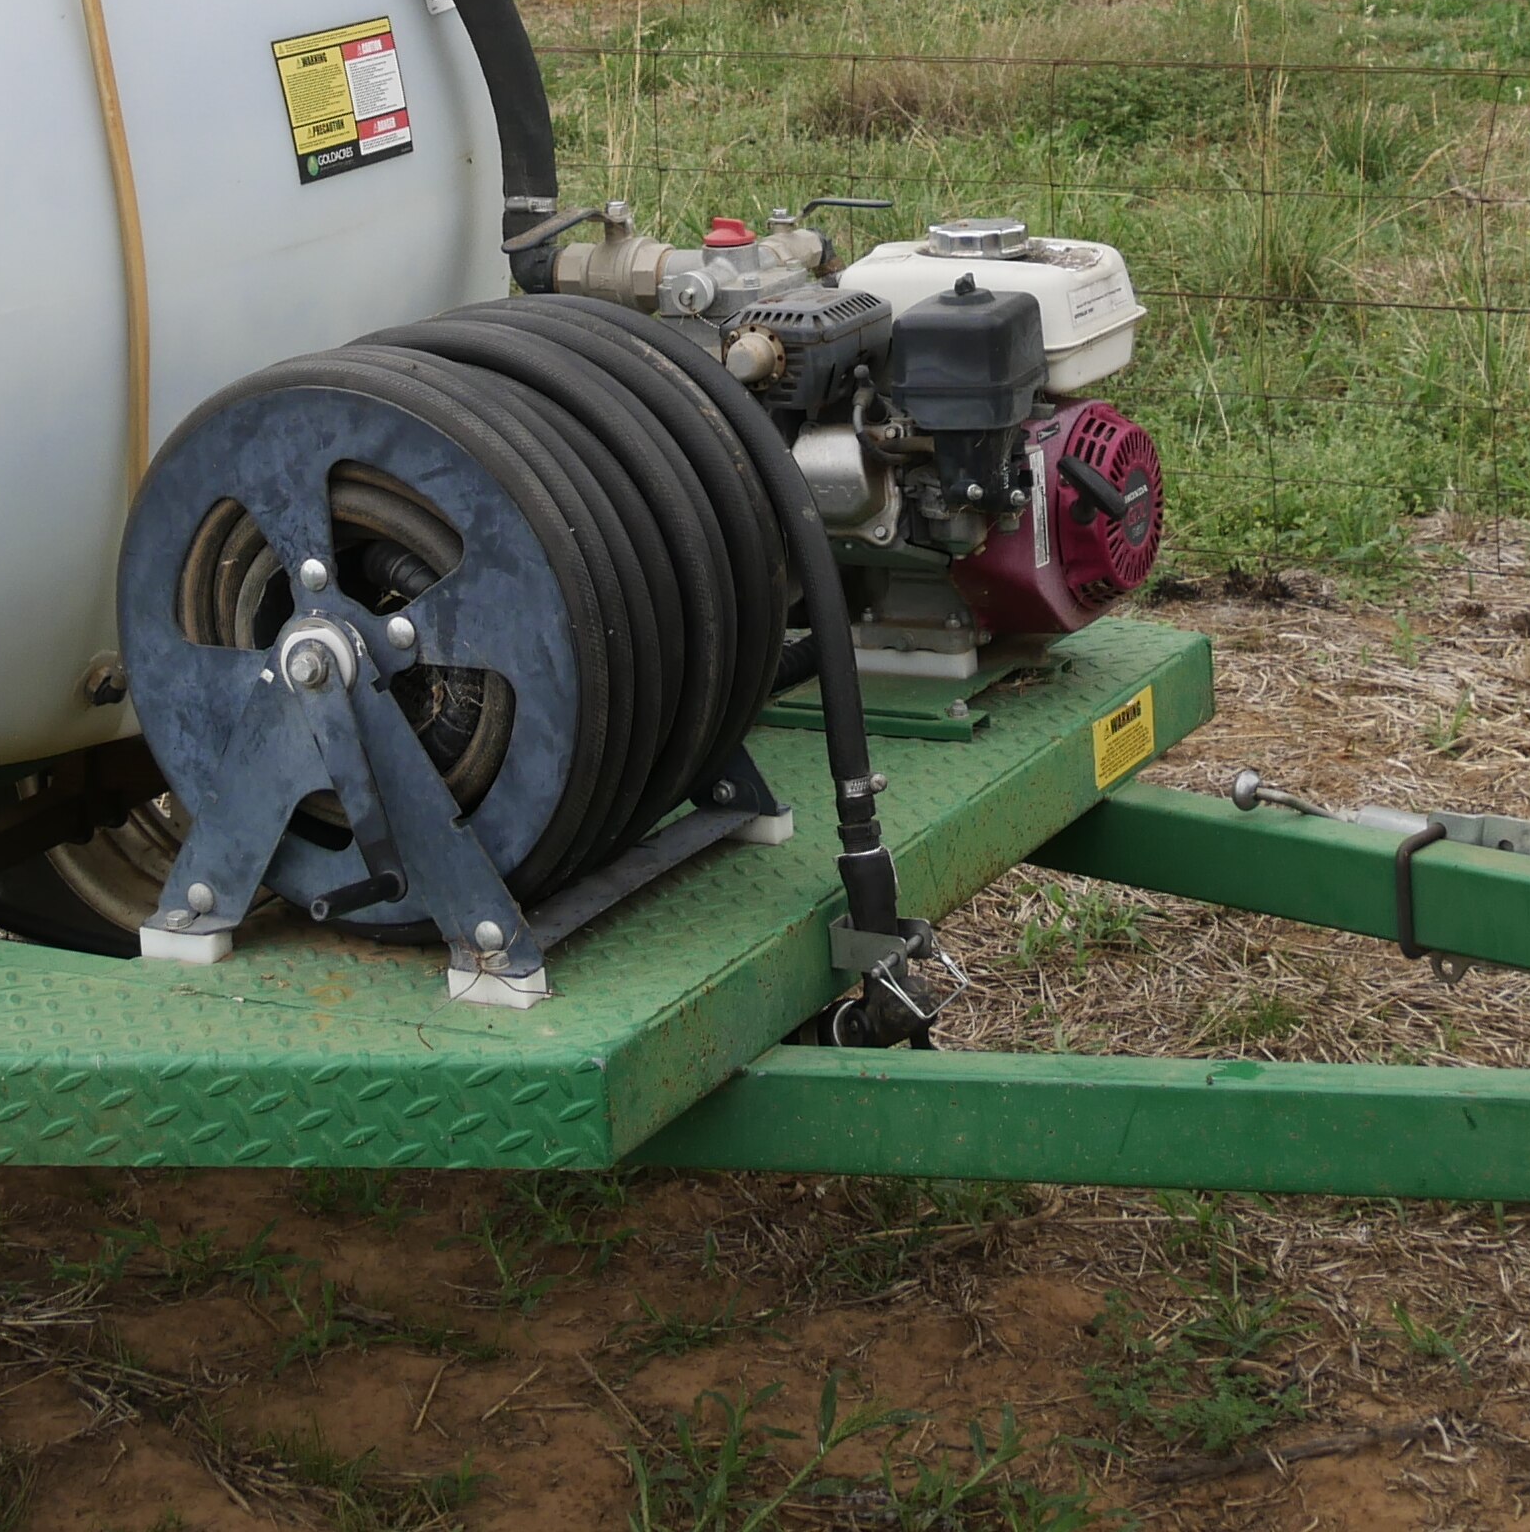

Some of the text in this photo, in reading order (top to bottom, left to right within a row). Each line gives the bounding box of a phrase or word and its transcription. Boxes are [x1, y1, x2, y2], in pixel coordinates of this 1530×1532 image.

[318, 146, 354, 166] GOLDACRES
[1124, 484, 1148, 504] HONDA
[1110, 699, 1142, 735] WARNING
